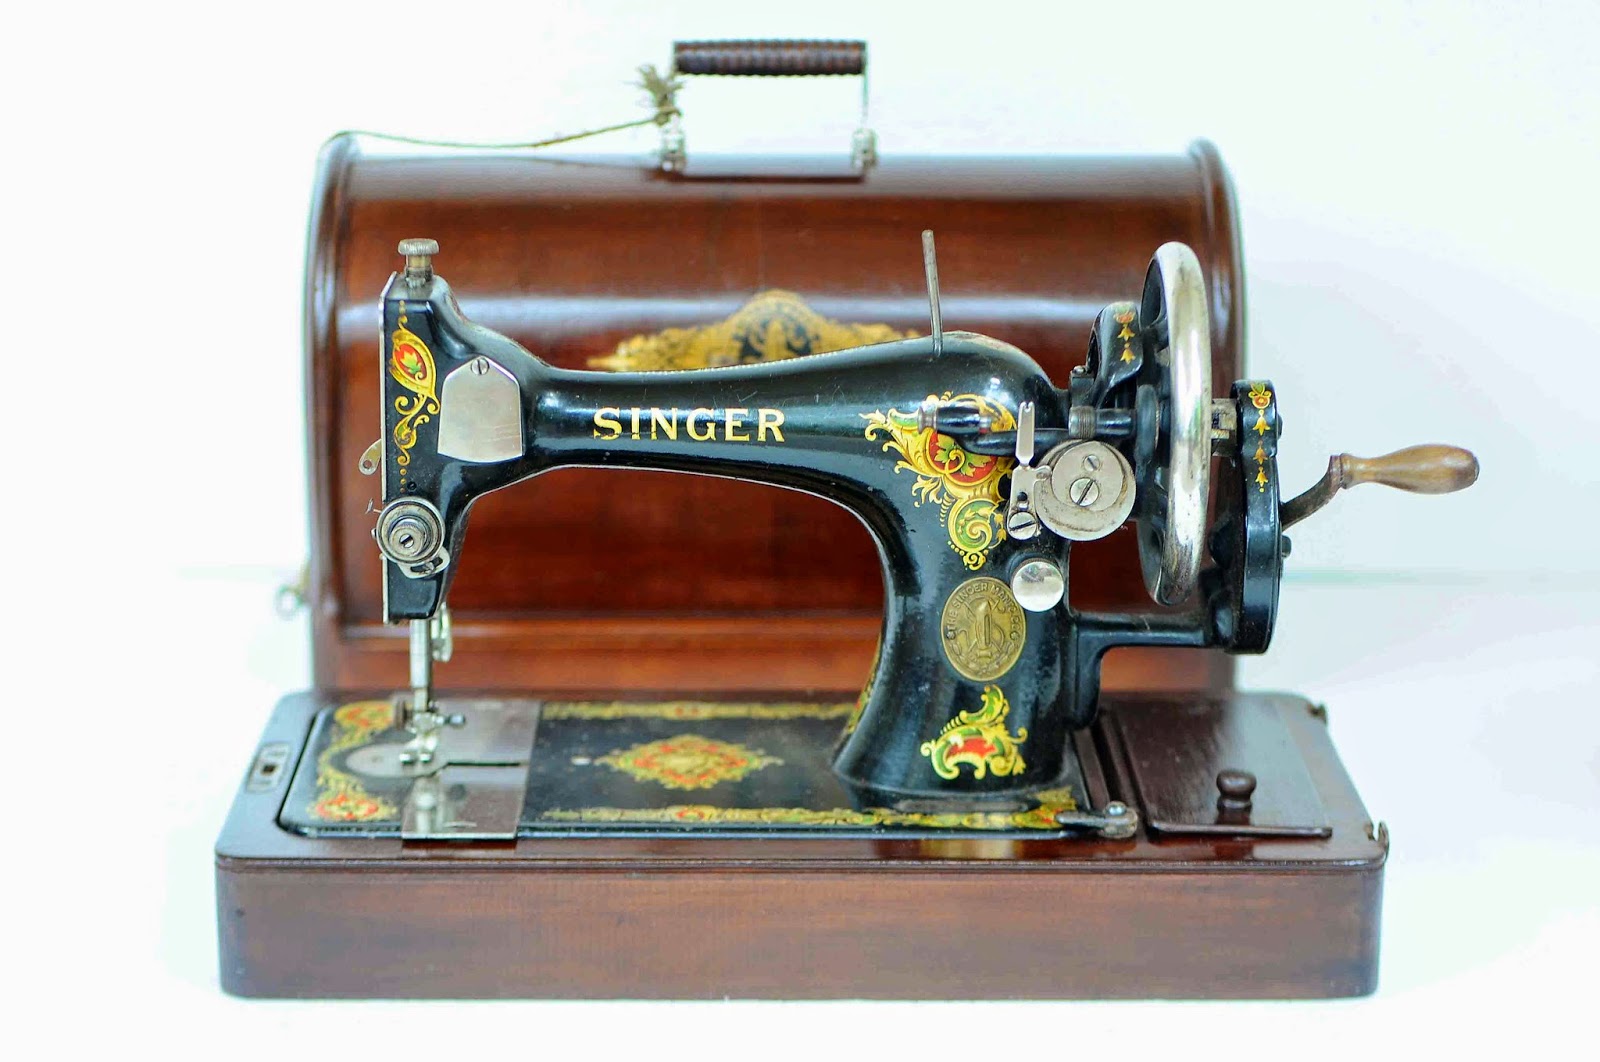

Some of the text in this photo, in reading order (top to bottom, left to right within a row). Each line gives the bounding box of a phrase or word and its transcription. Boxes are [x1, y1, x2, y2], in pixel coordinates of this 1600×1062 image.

[593, 407, 785, 441] SINGER
[946, 611, 958, 630] THE
[953, 583, 988, 608] SINGER
